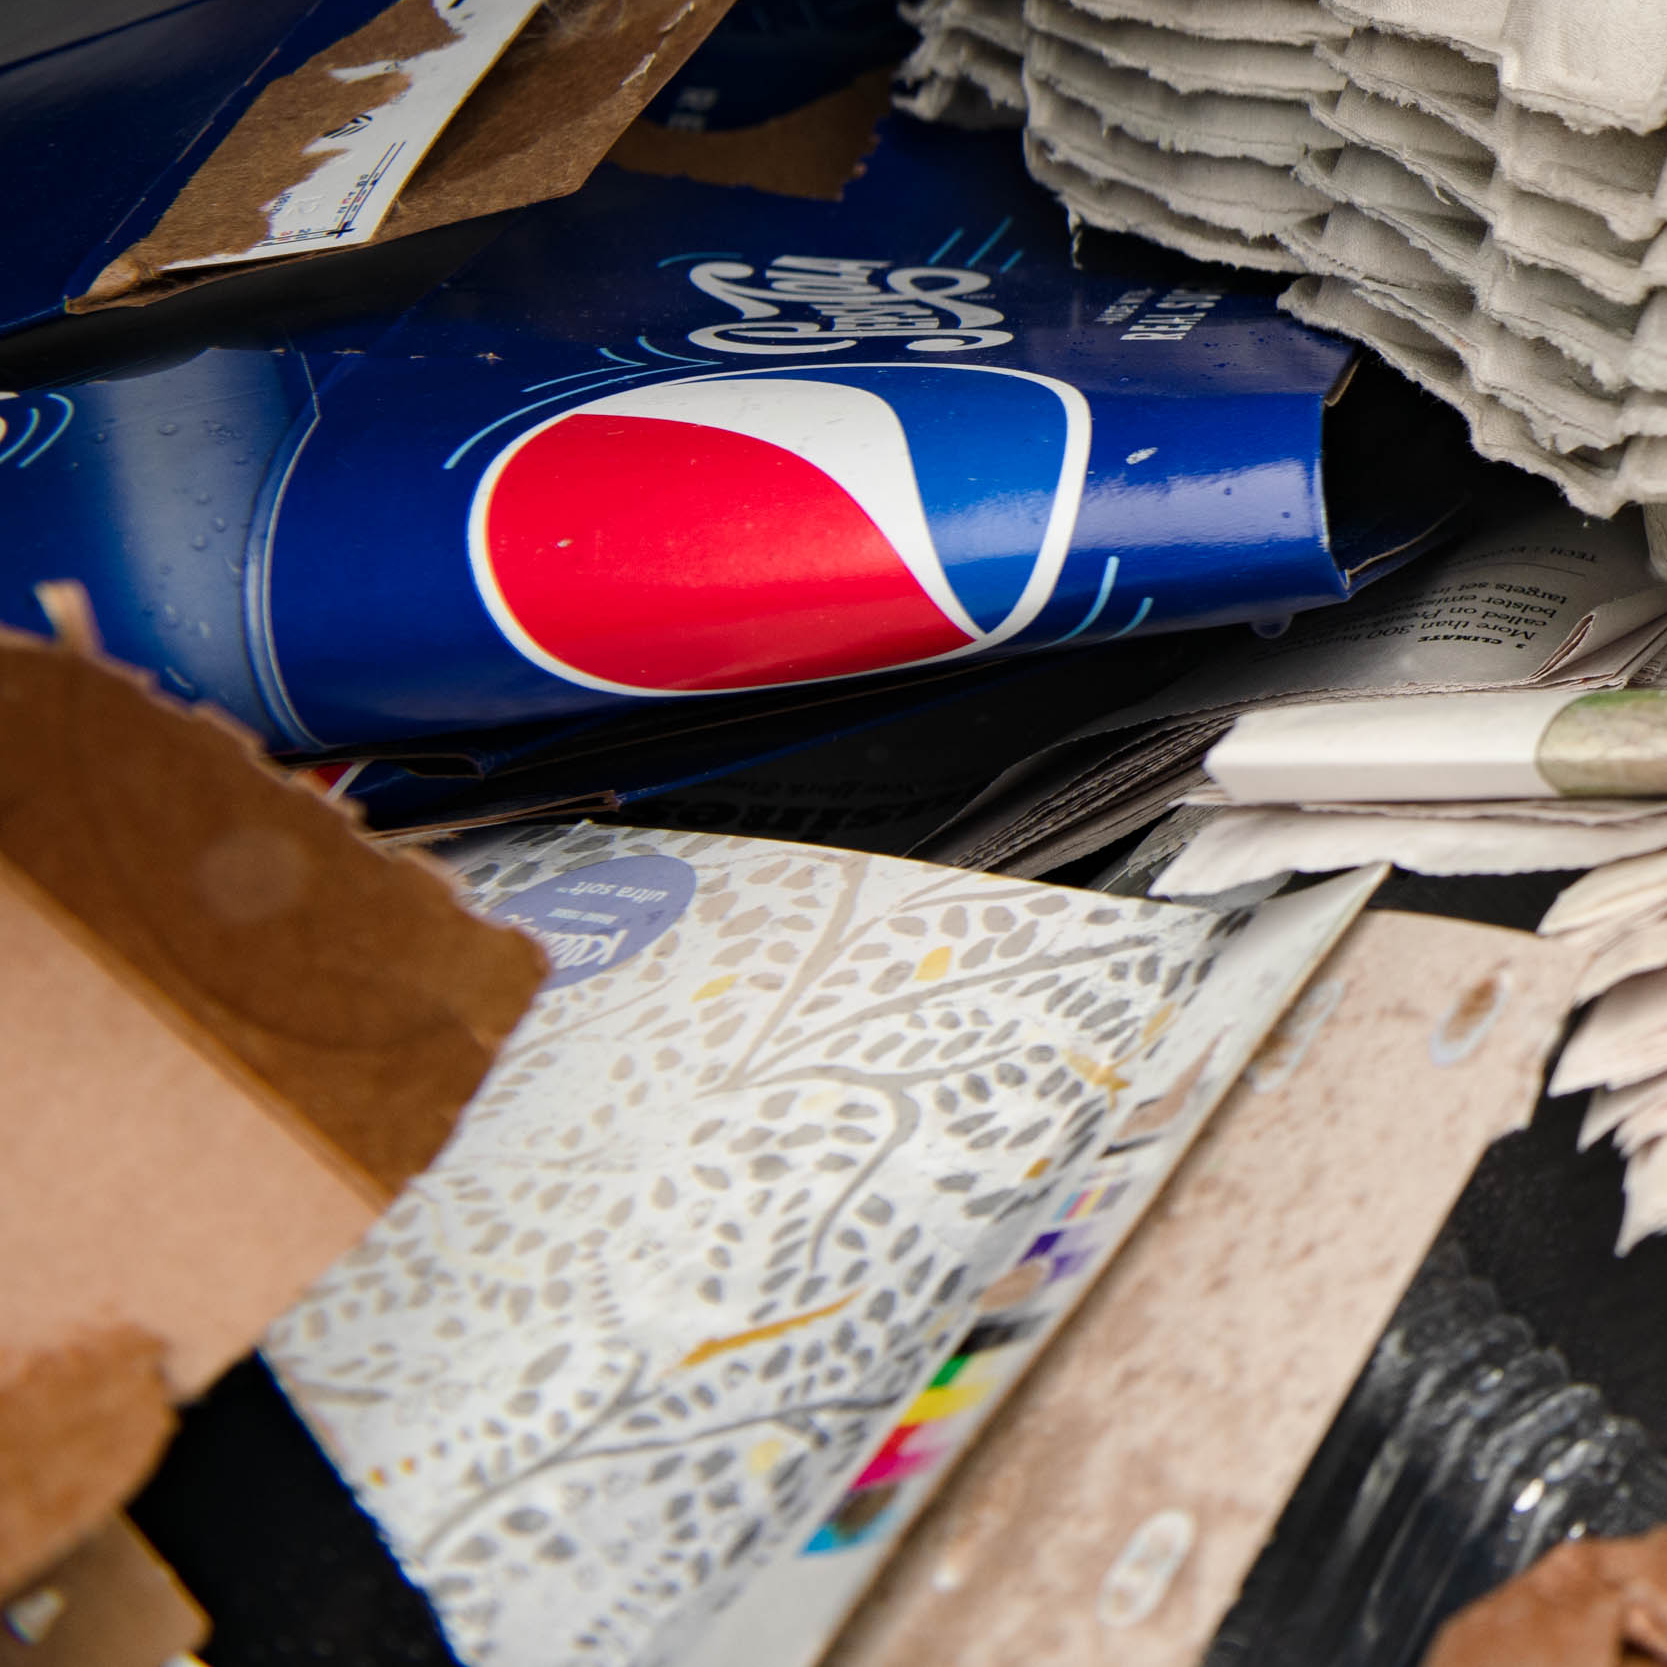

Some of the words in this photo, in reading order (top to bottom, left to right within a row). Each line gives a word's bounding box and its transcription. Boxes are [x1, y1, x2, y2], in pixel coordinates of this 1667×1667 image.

[1120, 313, 1206, 340] REAL
[1459, 581, 1490, 593] set
[1495, 582, 1567, 605] targets
[1450, 606, 1477, 616] on
[1481, 595, 1558, 619] bolster
[1421, 619, 1470, 631] than
[1482, 610, 1548, 627] called
[1366, 624, 1415, 640] 300
[1418, 634, 1503, 645] CLIMATE
[1476, 621, 1536, 641] More
[615, 885, 669, 904] ultra
